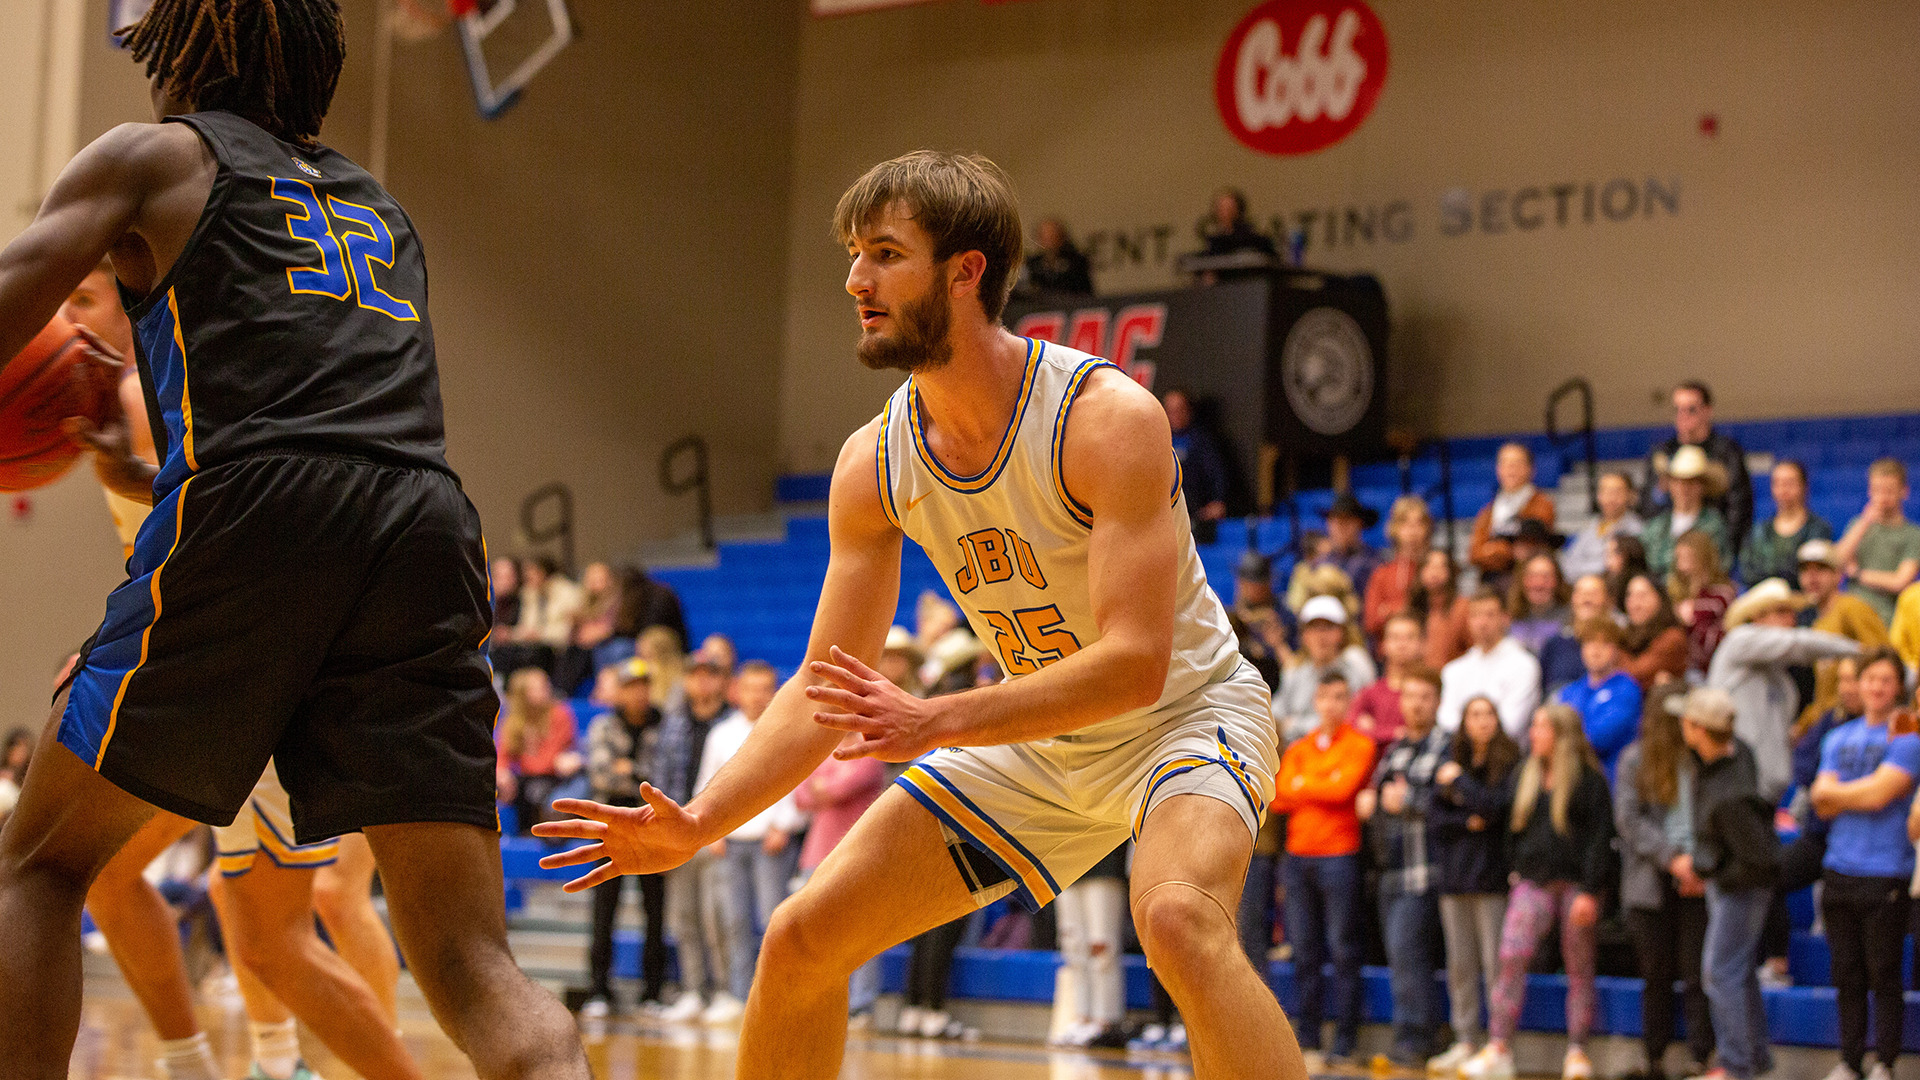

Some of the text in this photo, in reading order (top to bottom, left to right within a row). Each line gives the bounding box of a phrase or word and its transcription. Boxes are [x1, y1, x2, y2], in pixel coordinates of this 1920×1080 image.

[1234, 9, 1367, 132] Cobb
[267, 175, 421, 322] 32
[1084, 223, 1172, 271] ENT
[1438, 177, 1681, 237] SECTION
[955, 527, 1048, 595] JBU
[978, 603, 1082, 676] 25
